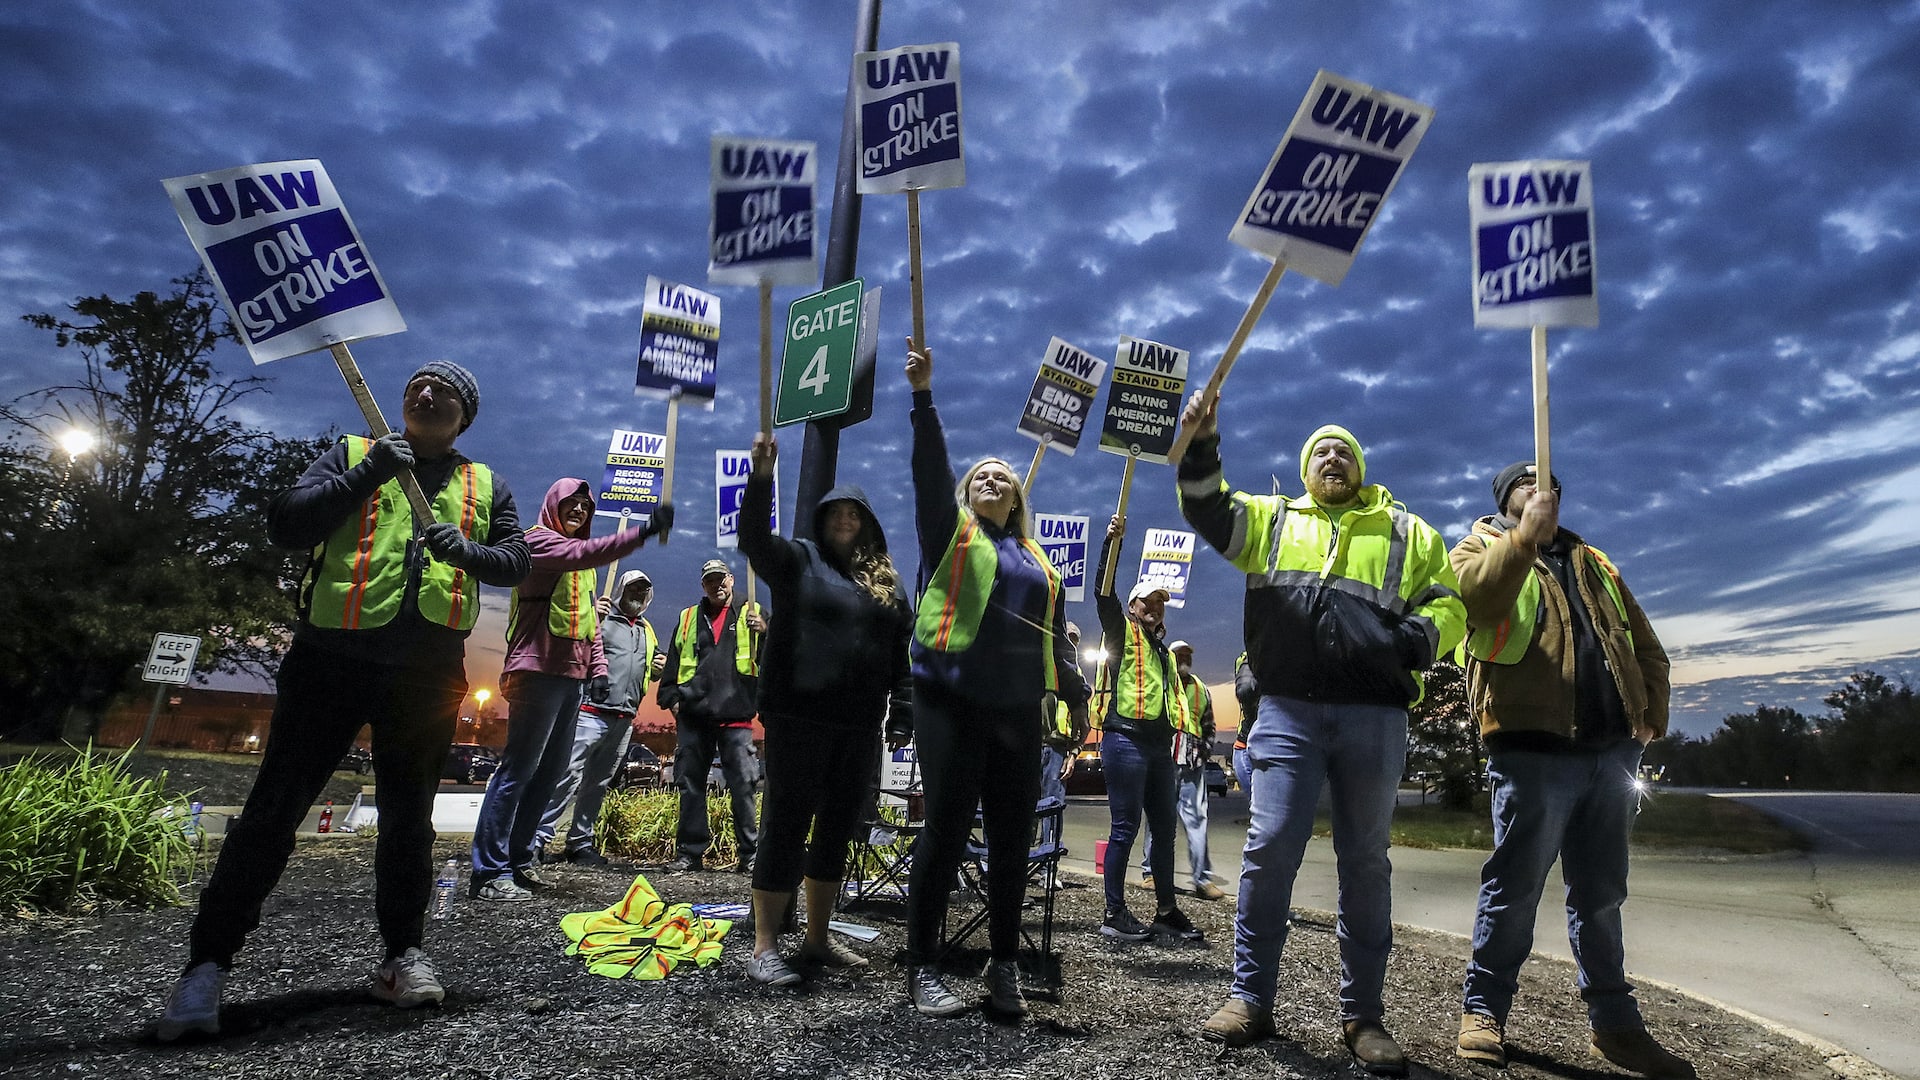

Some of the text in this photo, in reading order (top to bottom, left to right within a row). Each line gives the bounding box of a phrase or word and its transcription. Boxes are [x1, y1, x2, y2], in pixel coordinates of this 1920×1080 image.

[866, 51, 949, 89] UAW
[888, 92, 925, 132] ON
[1310, 83, 1421, 150] UAW
[863, 112, 958, 176] STRIKE
[721, 146, 809, 179] UAW
[1301, 152, 1361, 190] ON
[185, 170, 321, 226] UAW
[1484, 172, 1582, 207] UAW
[741, 185, 781, 226] ON
[1247, 188, 1382, 229] STRIKE
[253, 223, 313, 276] ON
[713, 210, 812, 263] STRIKE
[1507, 213, 1554, 262] ON
[1479, 240, 1591, 304] STRIKE
[238, 242, 370, 338] STRIKE
[658, 283, 709, 318] UAW
[791, 299, 855, 341] GATE
[654, 333, 706, 356] SAVING
[1128, 341, 1178, 374] UAW
[641, 345, 715, 373] AMERICAN
[798, 344, 831, 396] 4
[1055, 345, 1098, 380] UAW
[1043, 368, 1094, 395] STAND UP
[1117, 372, 1181, 391] STAND UP
[1041, 386, 1082, 412] END
[1121, 392, 1168, 409] SAVING
[1030, 399, 1083, 431] TIERS
[1108, 406, 1175, 427] AMERICAN
[1116, 419, 1162, 437] DREAM
[621, 434, 663, 455] UAW
[611, 456, 664, 467] STAND UP
[615, 469, 655, 479] RECORD
[722, 457, 751, 477] UA
[610, 486, 651, 495] RECORD
[612, 477, 653, 487] PROFITS
[601, 492, 658, 504] CONTRACTS
[1040, 519, 1084, 539] UAW
[1155, 533, 1186, 549] UAW
[1050, 545, 1069, 565] ON
[1054, 559, 1084, 579] IKE
[1148, 562, 1181, 576] END
[159, 640, 192, 652] KEEP
[148, 664, 187, 676] RIGHT
